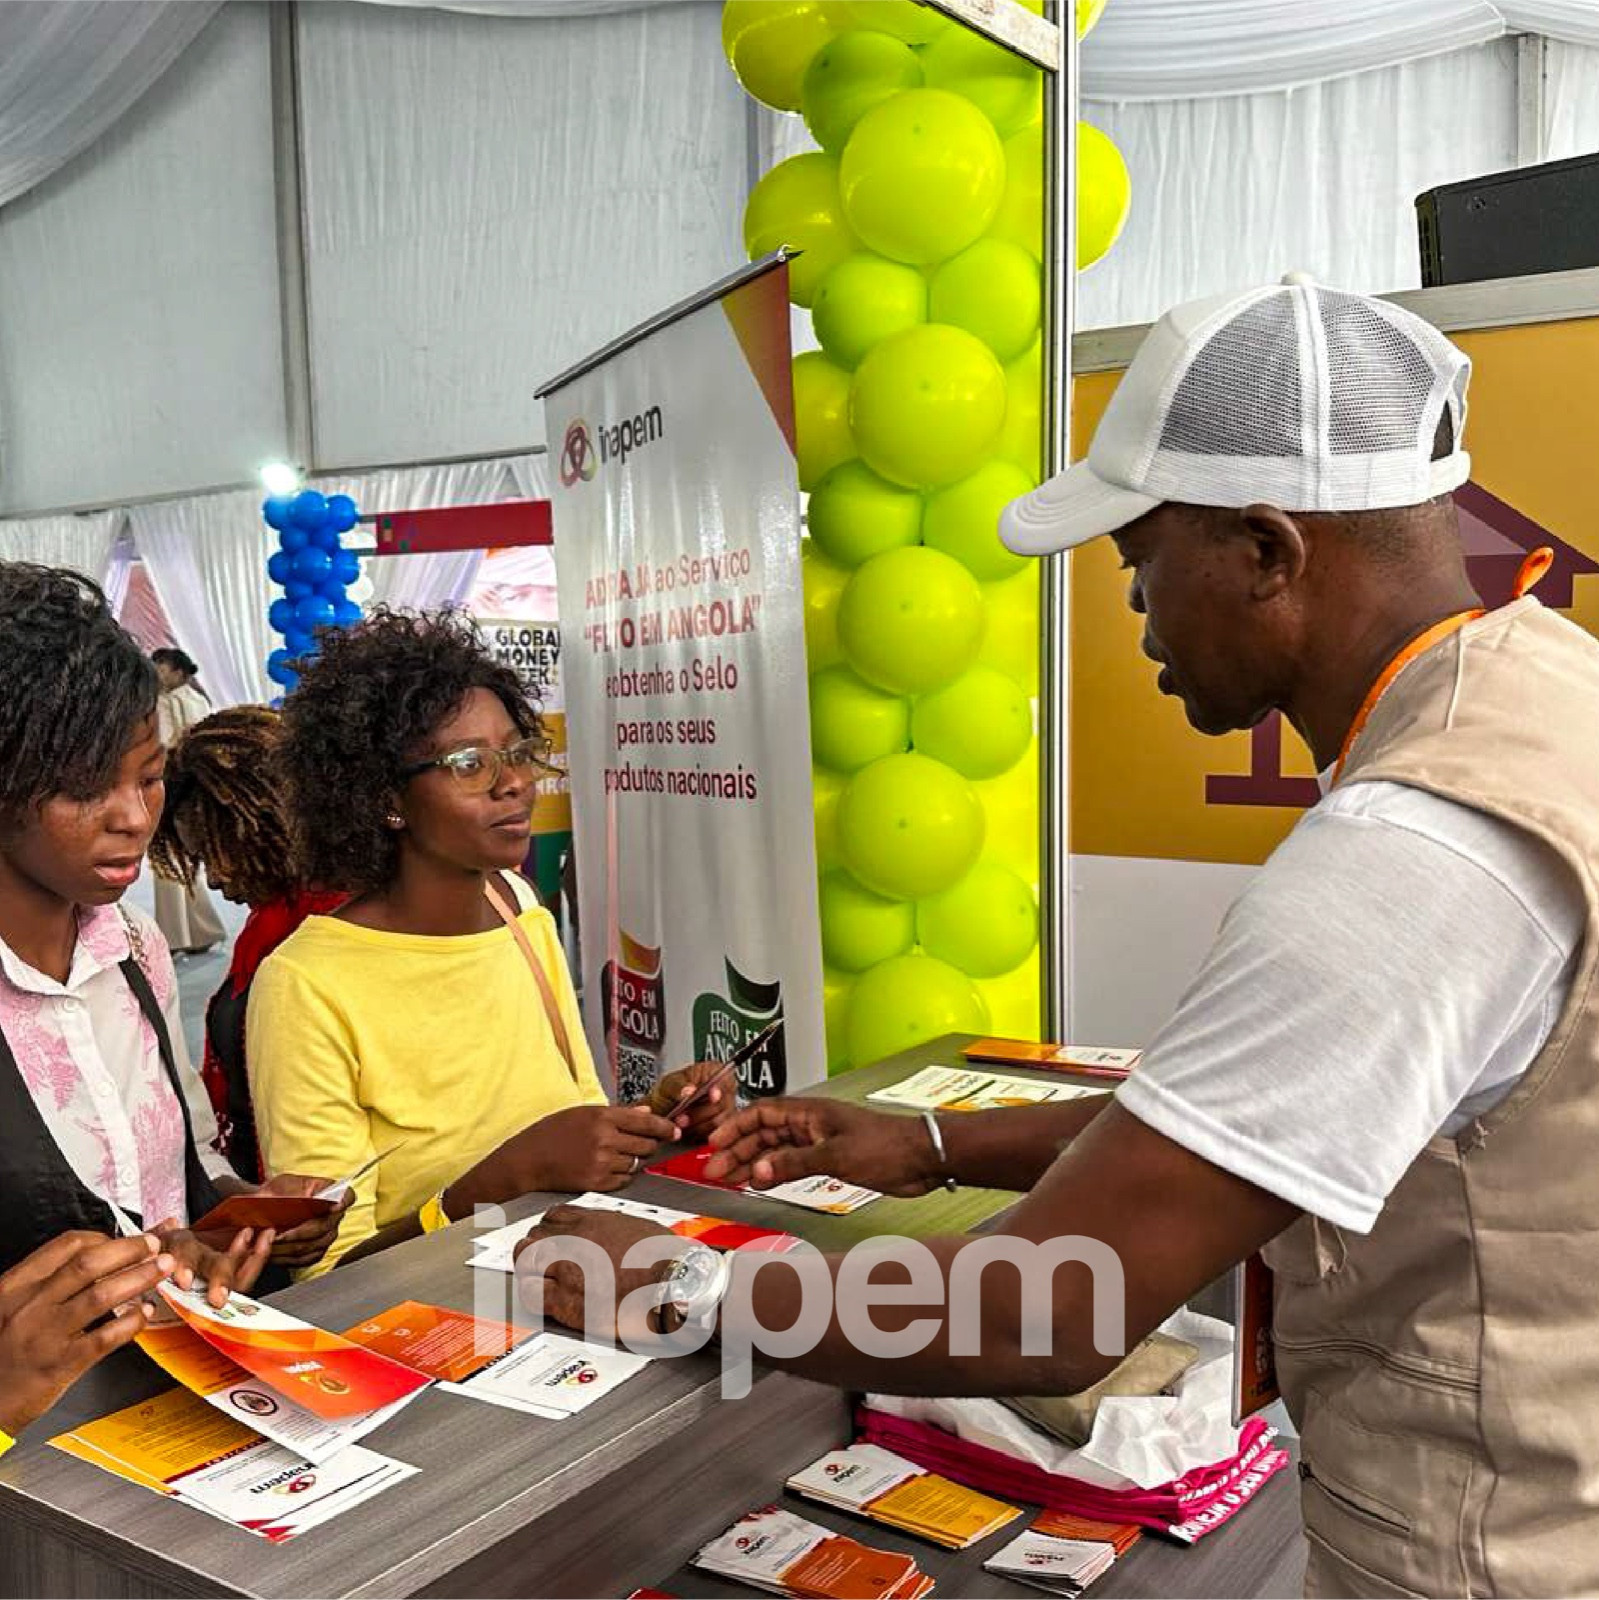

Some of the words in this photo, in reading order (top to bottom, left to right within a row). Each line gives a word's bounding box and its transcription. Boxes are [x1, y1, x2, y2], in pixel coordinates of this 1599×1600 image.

[599, 406, 662, 464] inapem
[656, 566, 675, 592] ao
[496, 630, 561, 647] GLOBA
[640, 612, 663, 645] EM
[496, 649, 561, 666] MONEY
[680, 668, 689, 692] o
[693, 655, 738, 691] Selo
[617, 720, 654, 750] para
[656, 719, 674, 744] os
[677, 718, 716, 744] seus
[668, 762, 758, 800] nacionais
[710, 1010, 740, 1043] FEITO
